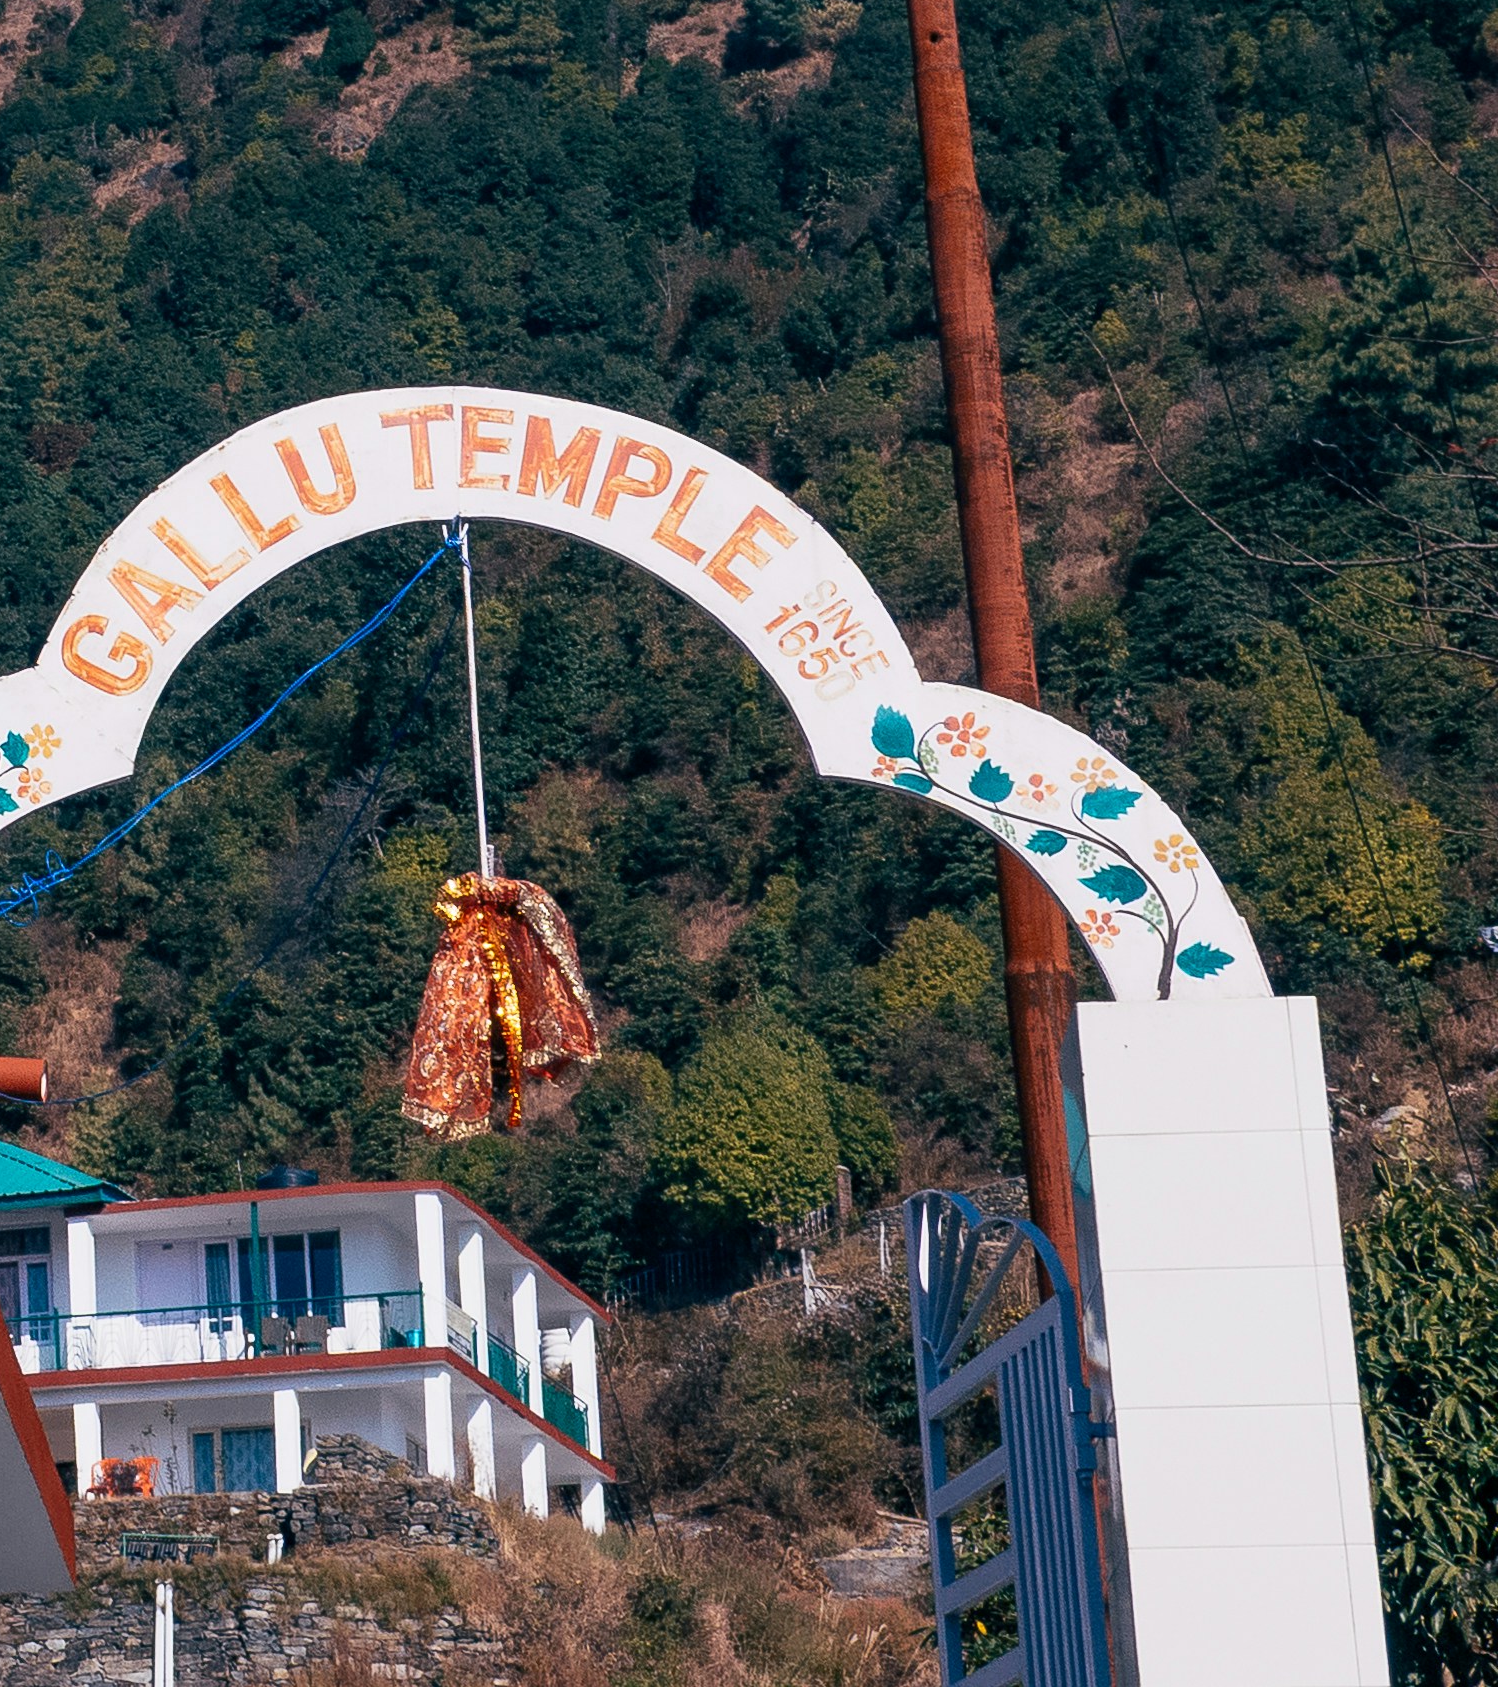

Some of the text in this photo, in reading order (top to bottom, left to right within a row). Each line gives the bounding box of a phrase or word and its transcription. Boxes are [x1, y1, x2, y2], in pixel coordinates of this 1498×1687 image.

[61, 404, 797, 697] GALLU TEMPLE
[763, 603, 856, 702] 1650
[804, 579, 890, 681] SINCE
